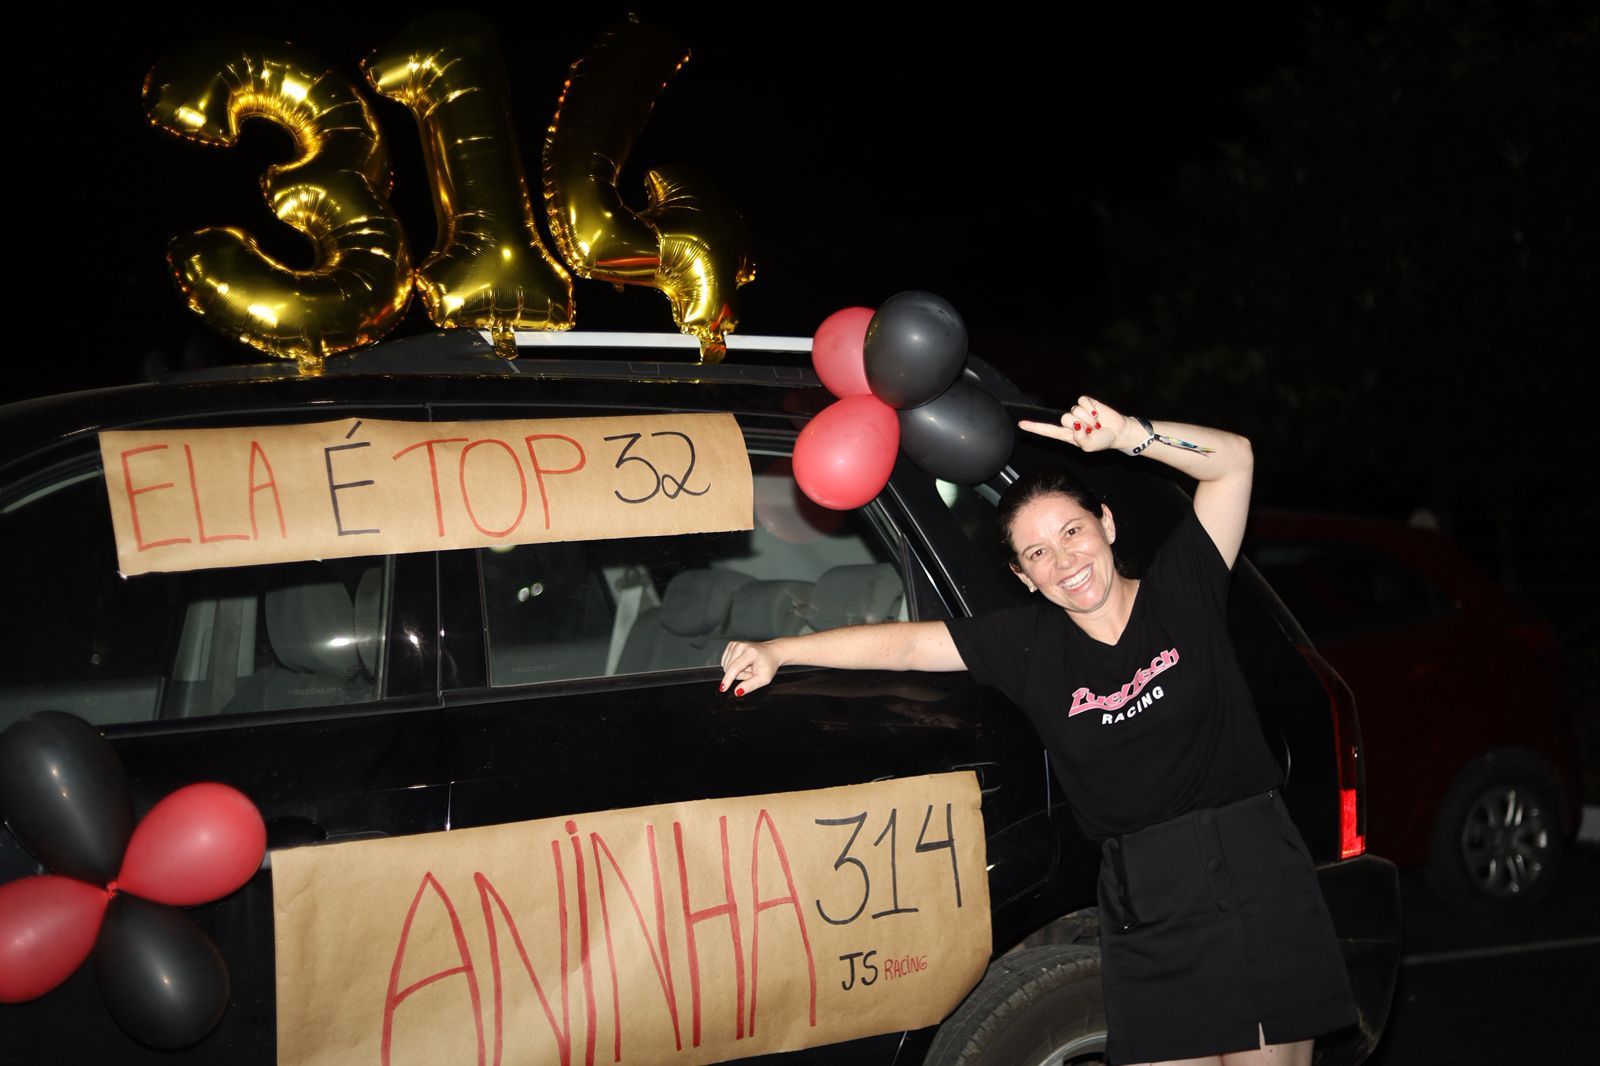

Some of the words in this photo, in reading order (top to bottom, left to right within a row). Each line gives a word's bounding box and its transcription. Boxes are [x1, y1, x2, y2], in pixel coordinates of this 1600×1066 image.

[141, 8, 758, 362] 314
[121, 442, 287, 551] ELA
[323, 420, 381, 536] É
[392, 433, 587, 538] TOP
[603, 430, 712, 504] 32
[1101, 685, 1165, 725] RACING
[381, 809, 817, 1066] ANINHA
[814, 803, 963, 925] 314
[839, 949, 878, 990] JS
